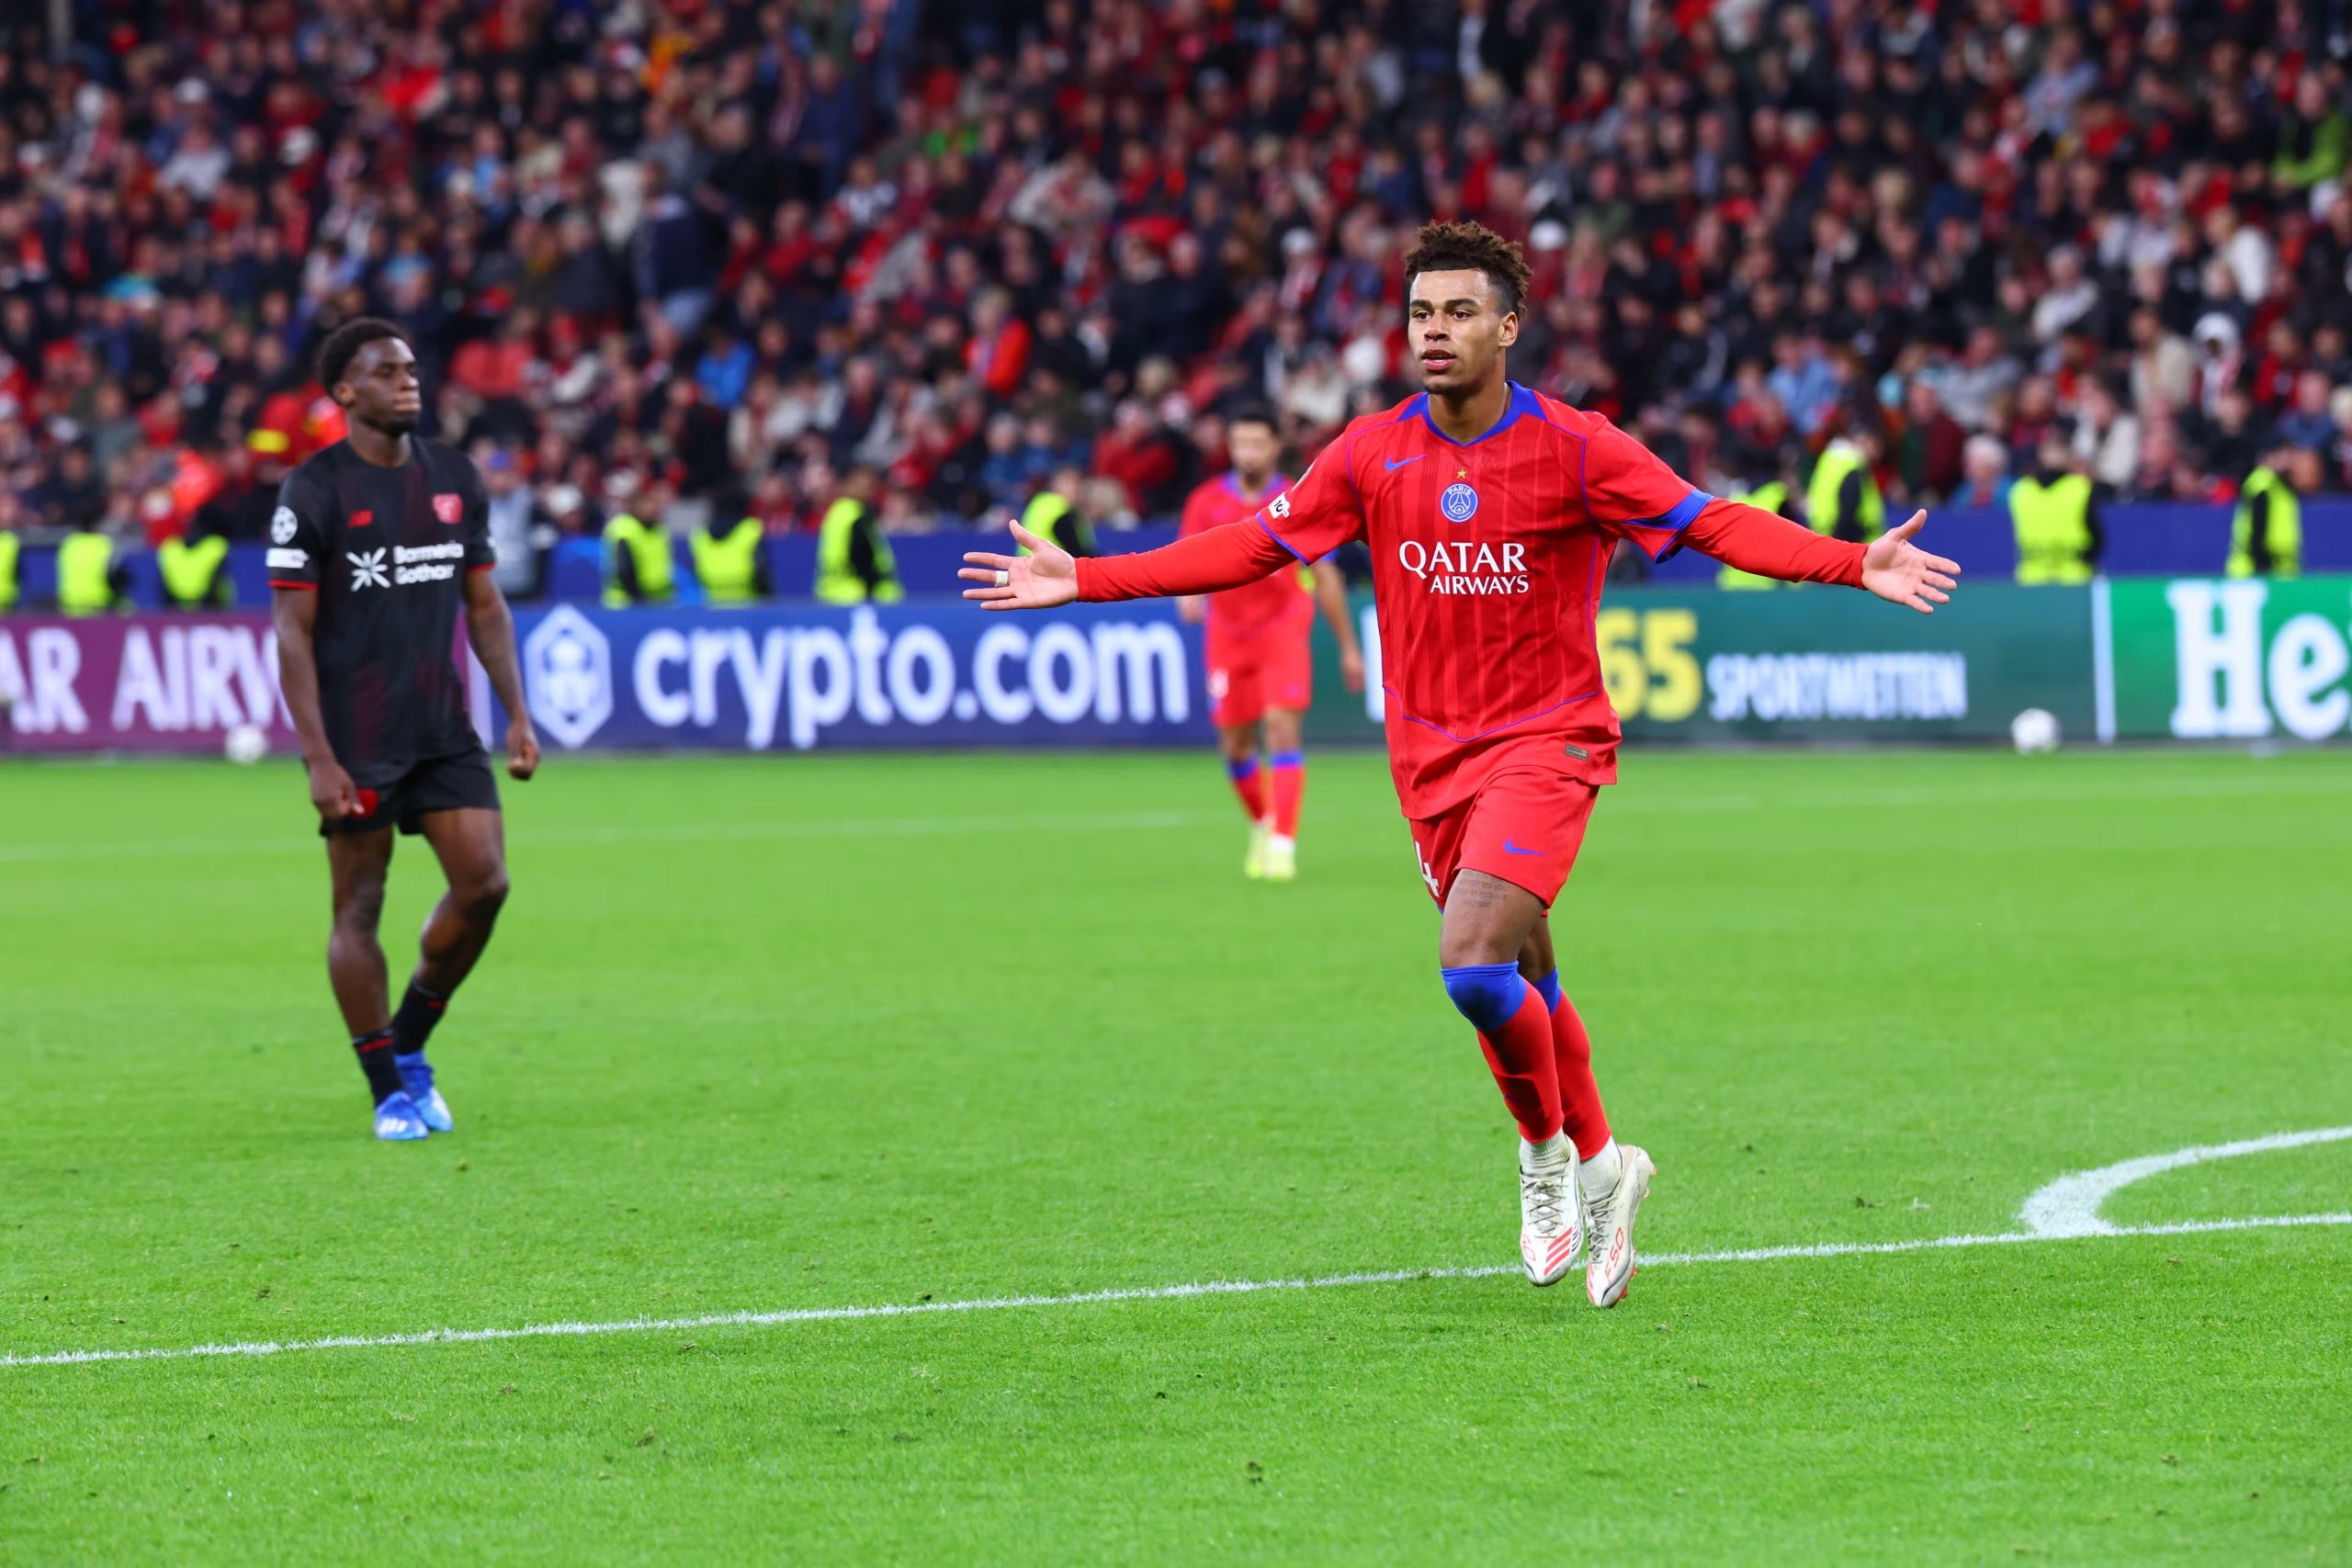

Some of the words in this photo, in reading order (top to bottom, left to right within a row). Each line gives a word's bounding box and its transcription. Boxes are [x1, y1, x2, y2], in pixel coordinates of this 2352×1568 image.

[1448, 486, 1471, 496] PARIS
[1399, 540, 1528, 581] QATAR
[1430, 575, 1530, 596] AIRWAYS
[632, 606, 1189, 749] crypto.com
[1705, 651, 1968, 722] SPORTWETTEN
[2165, 577, 2350, 740] He
